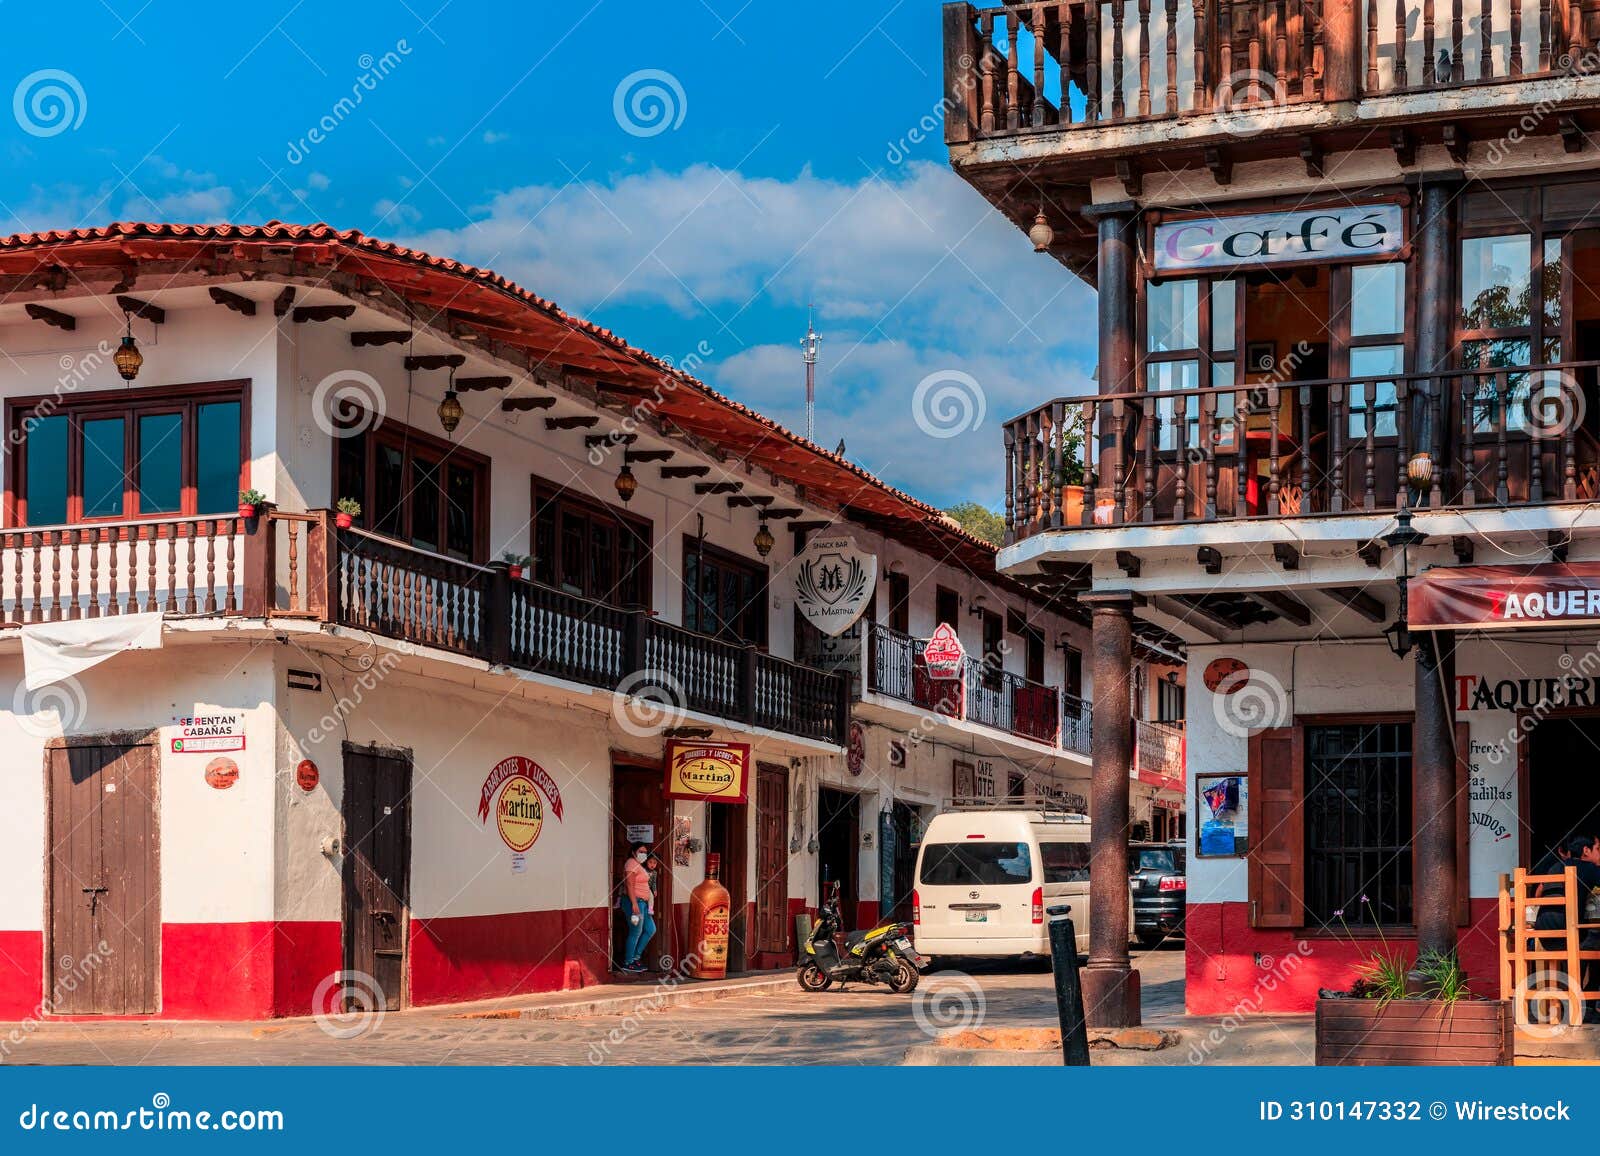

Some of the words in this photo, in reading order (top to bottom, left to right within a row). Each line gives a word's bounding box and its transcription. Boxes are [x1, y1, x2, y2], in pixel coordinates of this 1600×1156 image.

[1165, 213, 1387, 262] Café
[813, 541, 834, 550] SNACK
[835, 541, 848, 549] BAR
[180, 717, 192, 726] SE
[195, 716, 236, 726] RENTAN
[184, 725, 233, 736] CABAÑAS
[700, 761, 715, 771] La
[977, 759, 993, 777] CAFE
[483, 758, 519, 800] ABARROTES
[525, 760, 532, 776] Y
[533, 766, 560, 802] LICORES
[682, 771, 731, 783] Martina
[1468, 786, 1513, 801] sadillas
[500, 798, 542, 820] Martina
